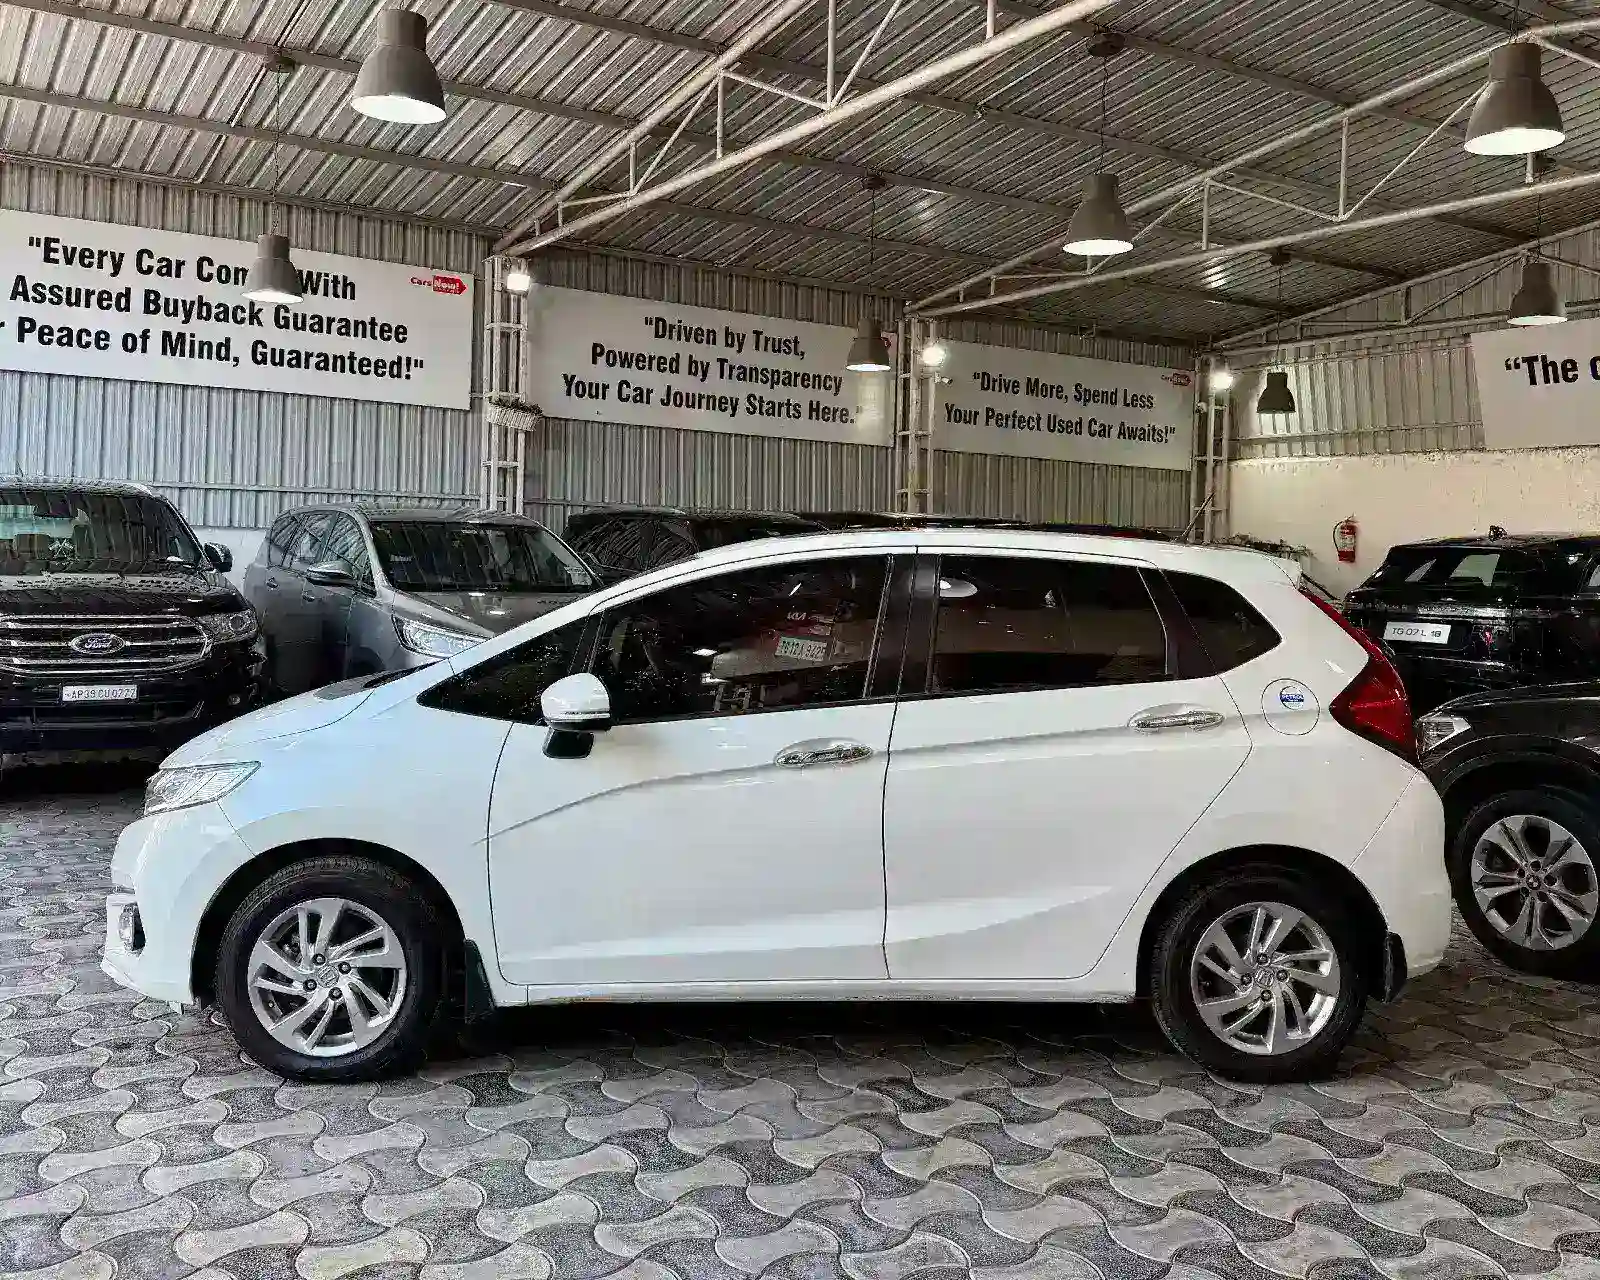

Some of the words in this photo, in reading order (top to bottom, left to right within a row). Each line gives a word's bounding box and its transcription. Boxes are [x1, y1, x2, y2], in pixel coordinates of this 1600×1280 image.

[28, 236, 126, 278] "Every
[135, 248, 186, 279] Car
[196, 255, 250, 287] Com
[296, 268, 356, 301] With
[9, 274, 132, 313] Assured
[142, 288, 264, 327] Buyback
[273, 304, 408, 344] Guarantee
[17, 316, 111, 351] Peace
[121, 329, 151, 354] of
[161, 330, 240, 368] Mind,
[251, 340, 424, 381] Guaranteed!"
[644, 316, 717, 346] "Driven
[724, 323, 747, 355] by
[752, 329, 806, 361] Trust,
[591, 342, 681, 375] Powered
[687, 353, 711, 383] by
[716, 356, 843, 397] Transparency
[562, 373, 610, 401] Your
[617, 379, 654, 406] Car
[659, 384, 740, 418] Journey
[745, 393, 802, 420] Starts
[1025, 376, 1069, 404] More,
[1073, 382, 1118, 407] Spend
[1122, 388, 1154, 410] Less
[944, 402, 980, 426] Your
[985, 406, 1042, 432] Perfect
[1046, 413, 1083, 436] Used
[1087, 417, 1114, 439] Car
[1116, 421, 1176, 444] Awaits!"
[84, 636, 112, 649] Ford
[1406, 628, 1419, 636] 07
